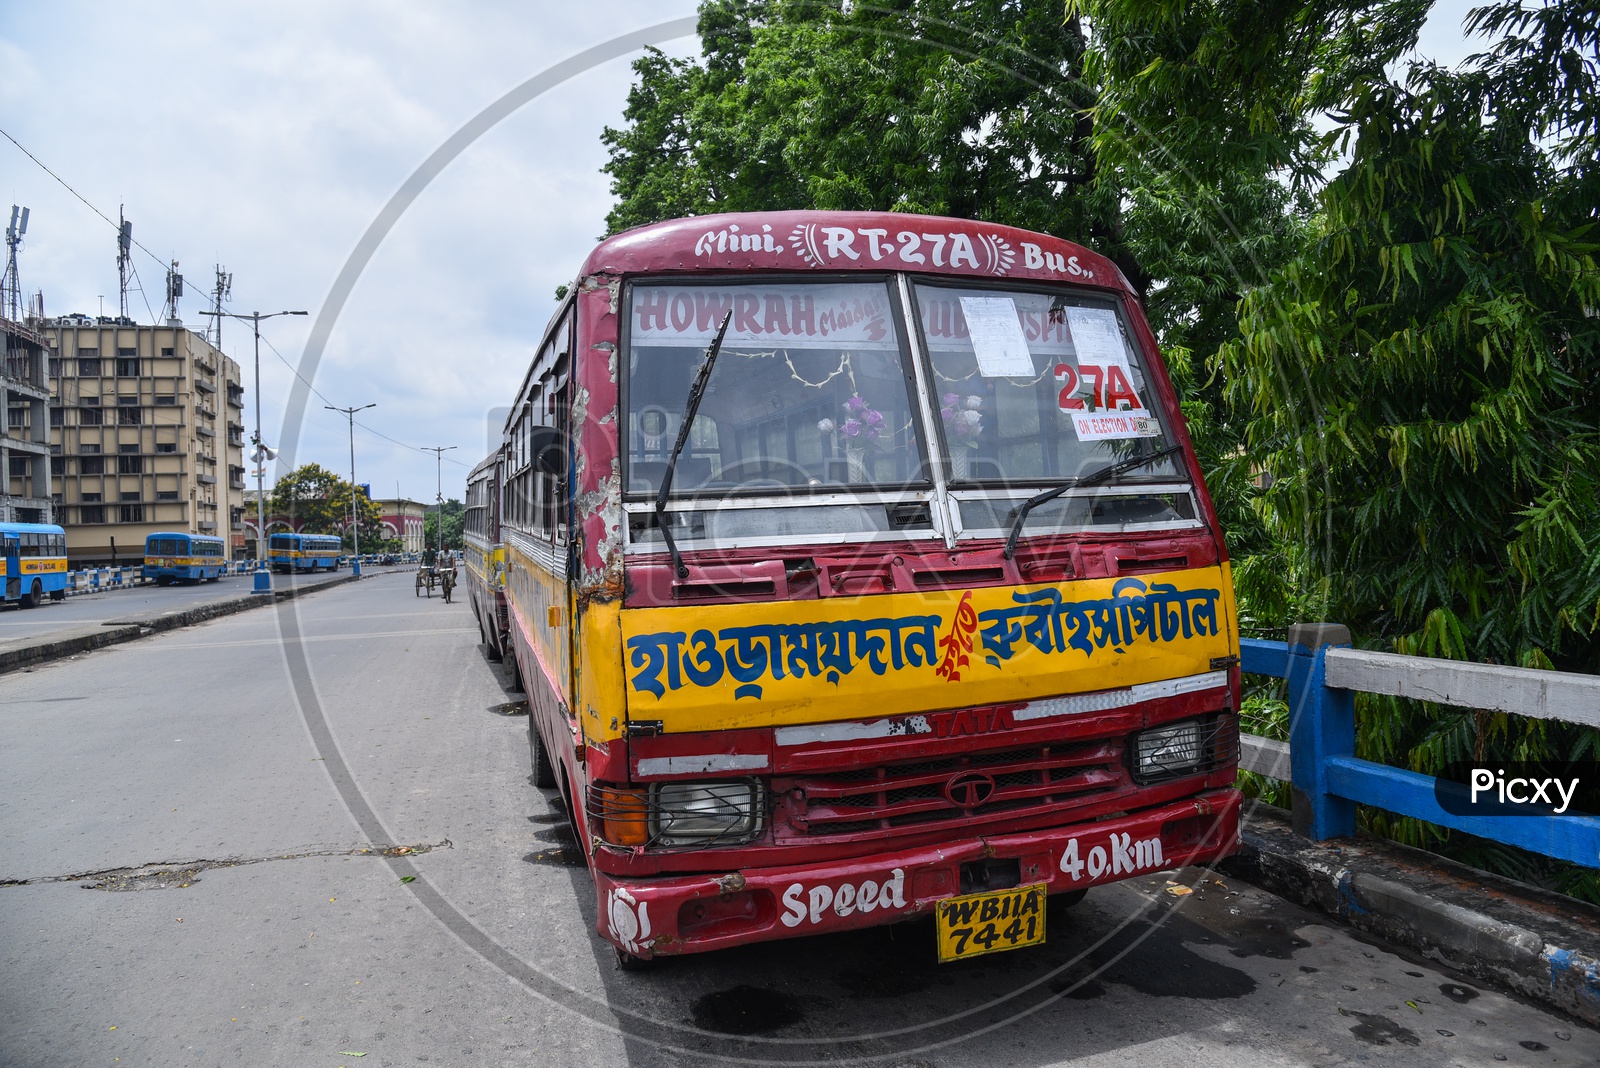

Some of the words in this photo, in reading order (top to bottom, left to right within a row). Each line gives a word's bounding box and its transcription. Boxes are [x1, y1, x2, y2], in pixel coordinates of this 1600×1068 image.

[636, 291, 819, 336] HOWRAH
[1054, 363, 1141, 409] 27A
[1078, 419, 1091, 434] ON
[1092, 417, 1129, 434] ELECTION
[932, 706, 1014, 737] TATA
[780, 868, 908, 927] Speed
[949, 915, 1037, 955] 7441
